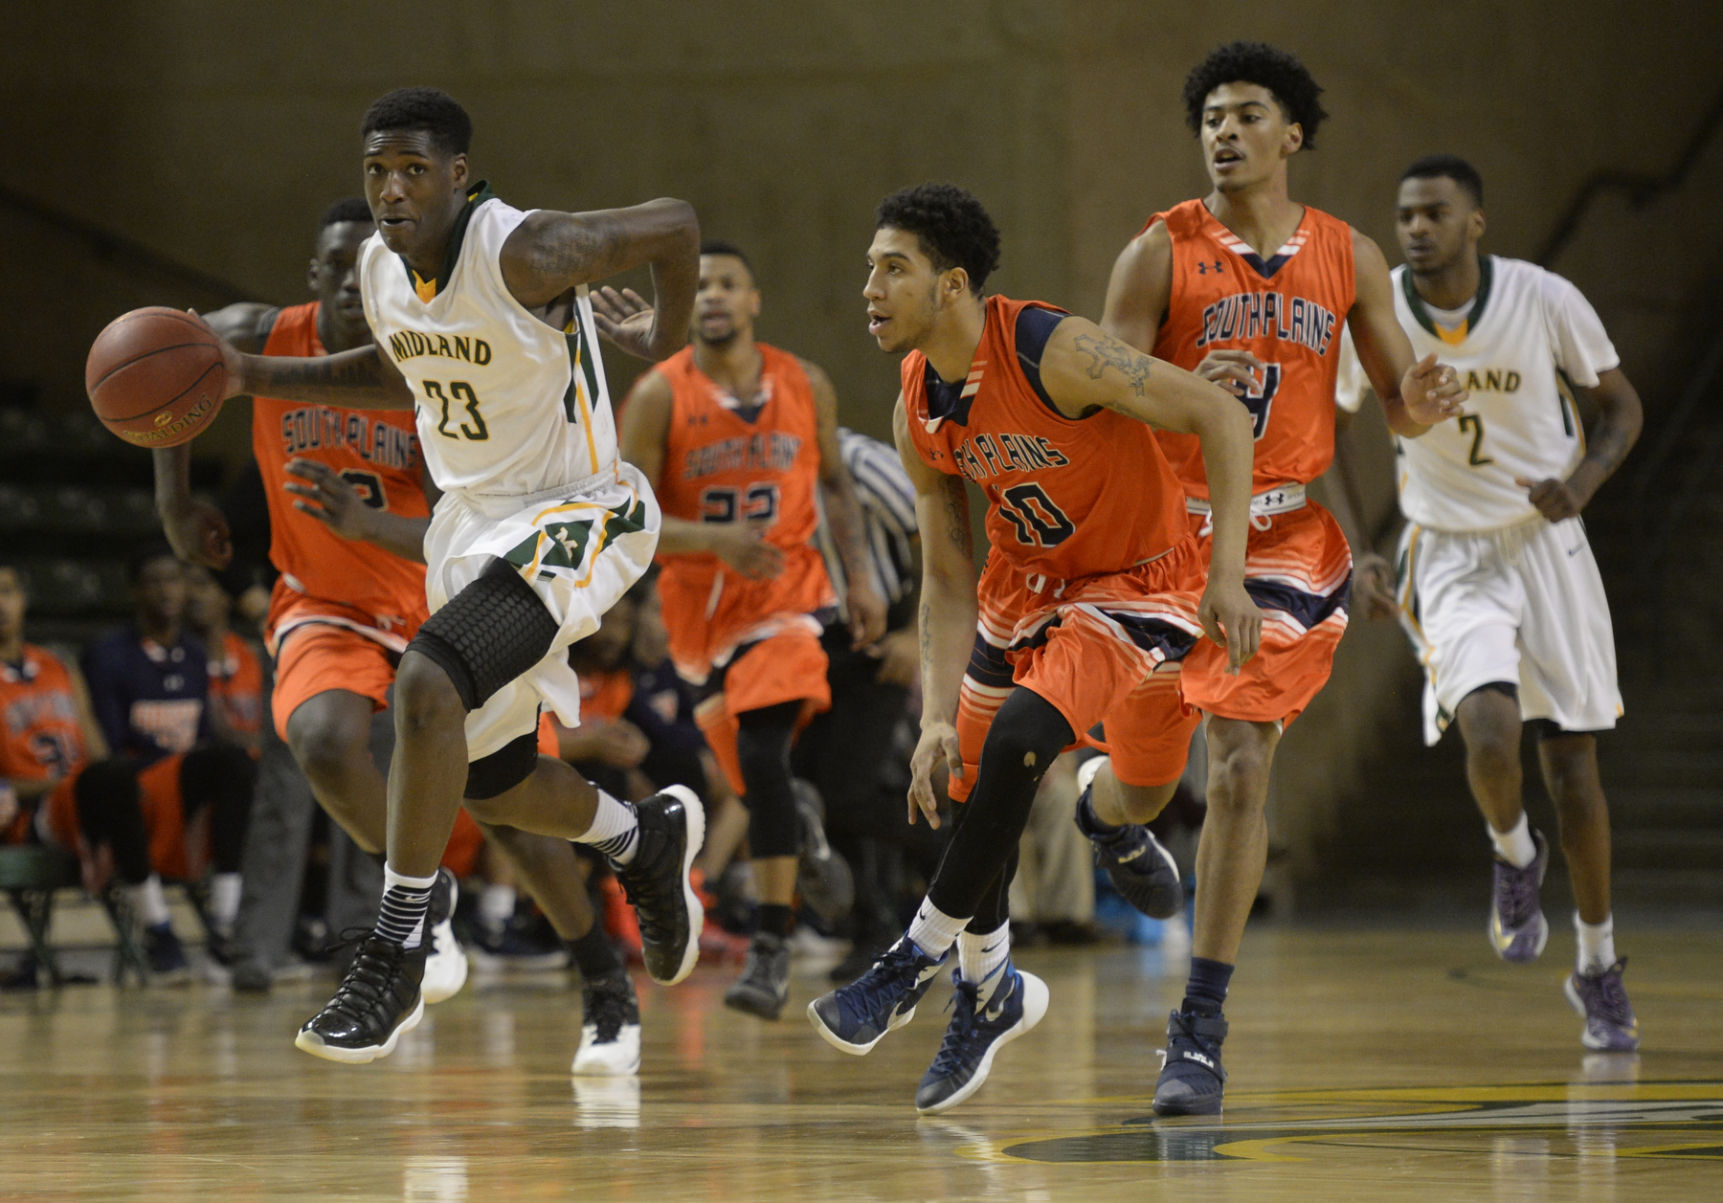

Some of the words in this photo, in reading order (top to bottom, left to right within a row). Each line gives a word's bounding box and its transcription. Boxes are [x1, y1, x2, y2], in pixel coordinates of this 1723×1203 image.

[388, 329, 492, 366] MIDLAND
[1197, 292, 1261, 347] SOUTH
[1262, 291, 1336, 357] PLAINS
[282, 405, 343, 456] SOUTH
[421, 379, 489, 441] 23
[973, 432, 1070, 476] PLAINS
[1458, 412, 1496, 467] 2
[992, 481, 1076, 549] 10
